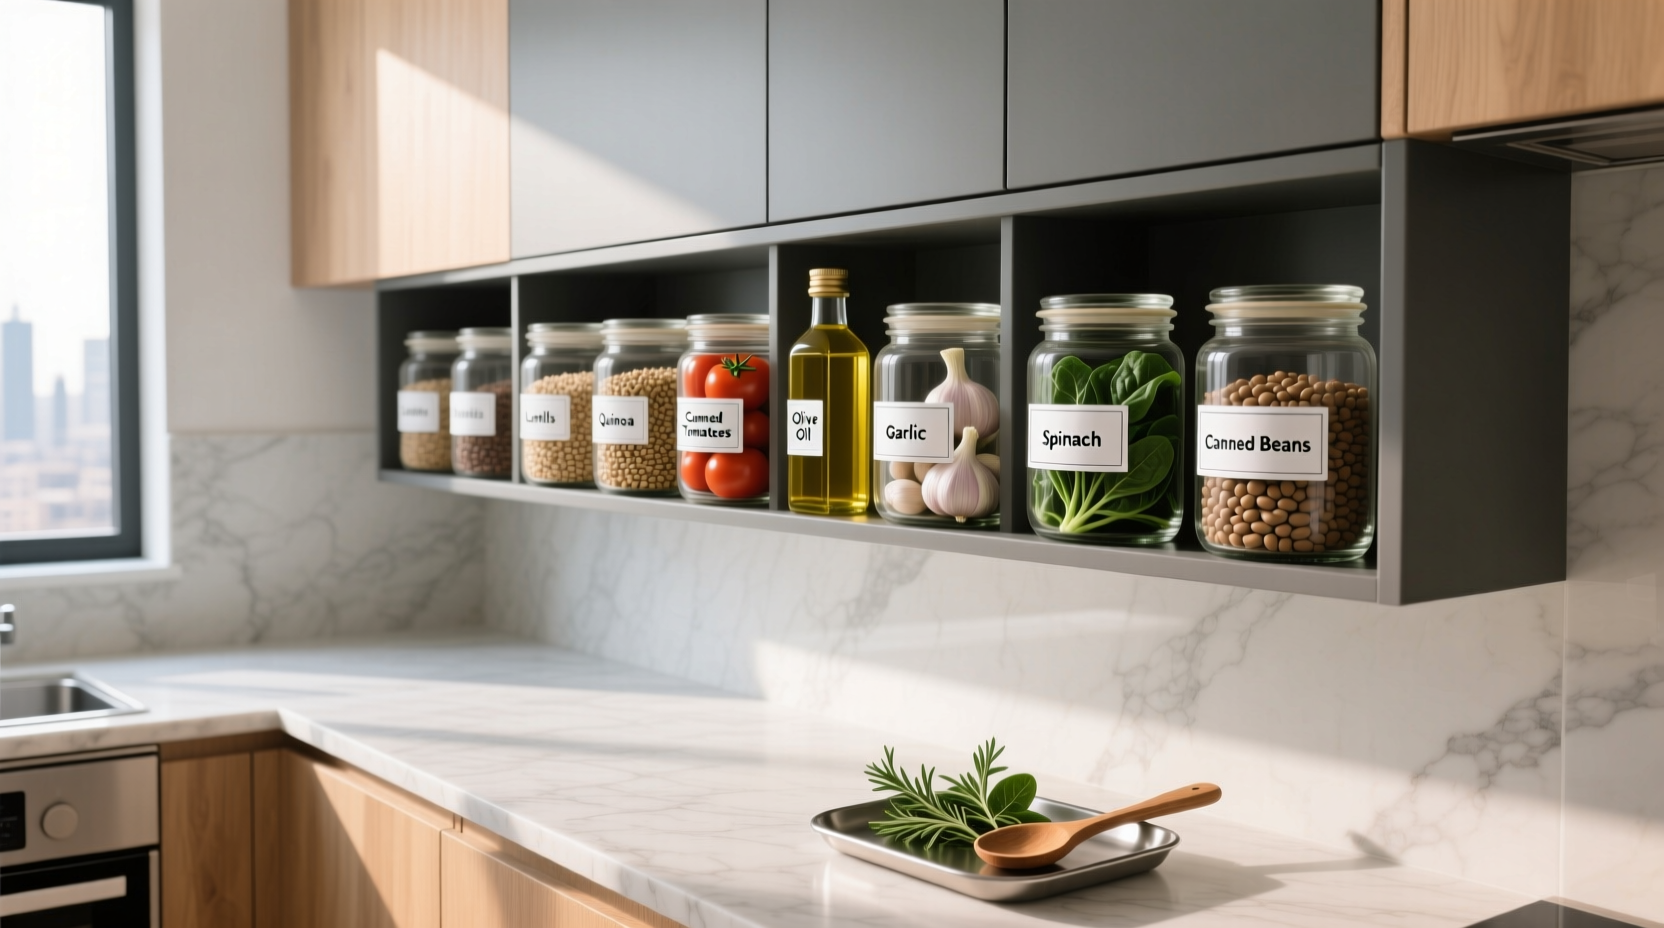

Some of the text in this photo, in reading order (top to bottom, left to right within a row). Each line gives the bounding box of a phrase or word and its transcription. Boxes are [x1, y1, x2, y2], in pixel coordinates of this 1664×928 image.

[598, 412, 635, 427] Quinoa
[791, 411, 819, 425] Olive
[885, 424, 927, 441] Garlic
[1042, 429, 1102, 450] Spinach
[1205, 434, 1311, 453] Canned Beans
